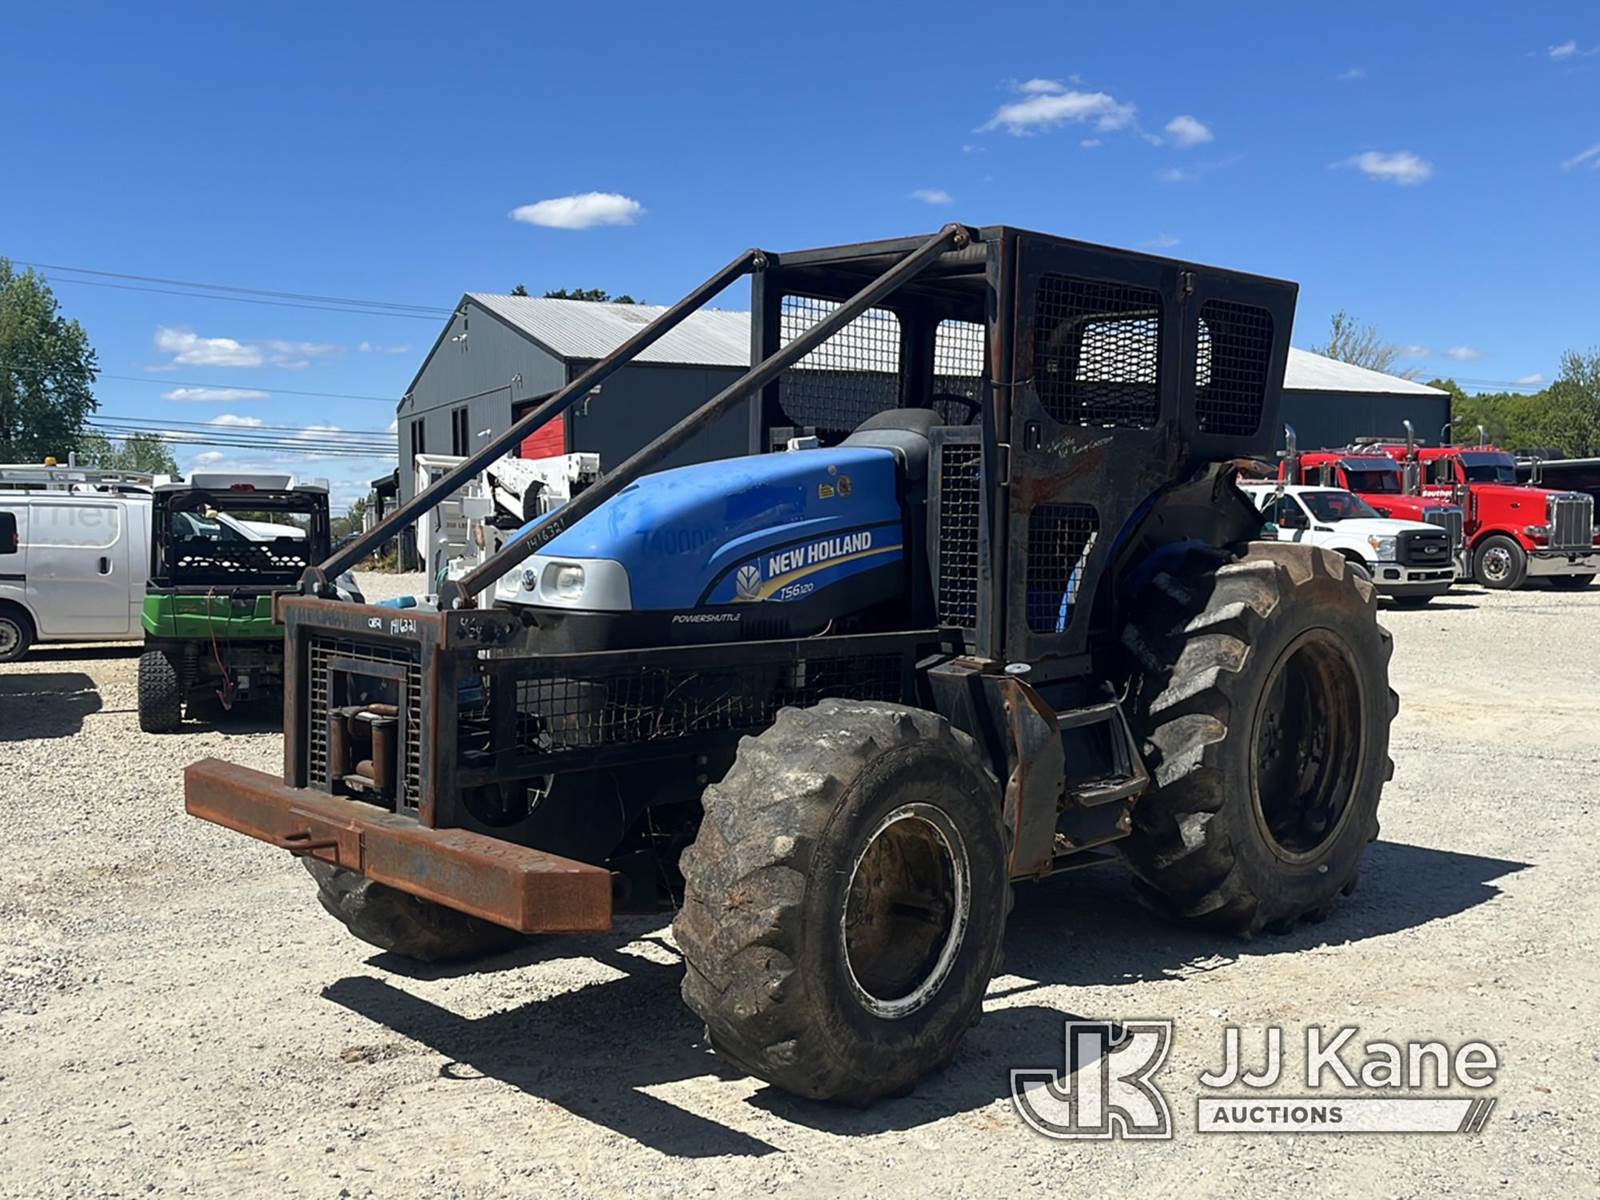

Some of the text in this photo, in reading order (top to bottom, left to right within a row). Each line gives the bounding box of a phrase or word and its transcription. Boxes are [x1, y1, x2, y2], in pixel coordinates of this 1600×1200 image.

[769, 531, 872, 577] NEW HOLLAND
[671, 612, 742, 624] POWERSHUTTLE
